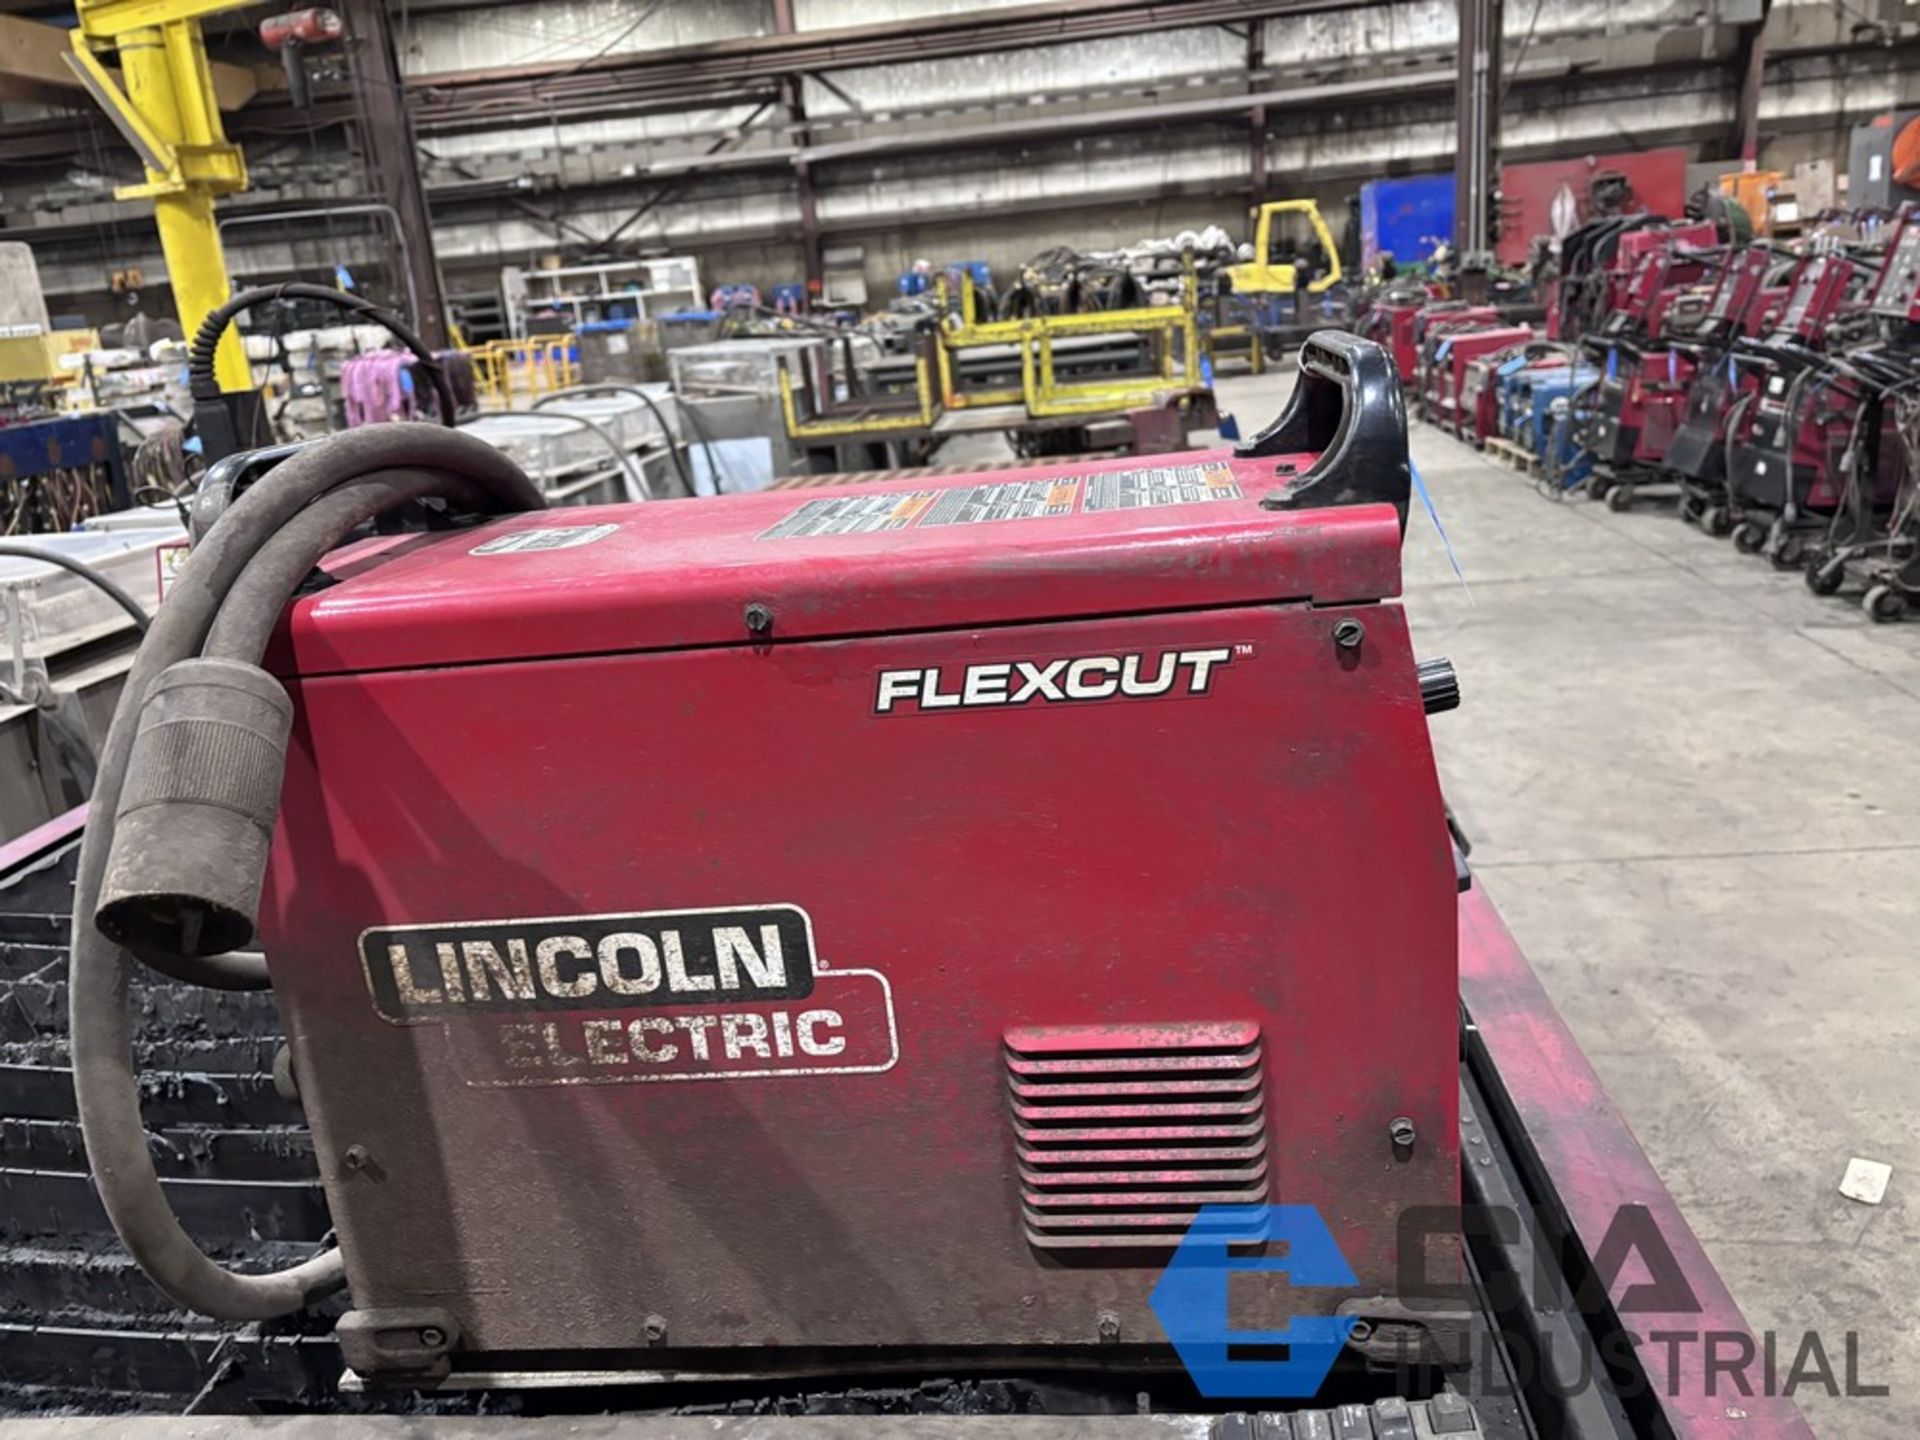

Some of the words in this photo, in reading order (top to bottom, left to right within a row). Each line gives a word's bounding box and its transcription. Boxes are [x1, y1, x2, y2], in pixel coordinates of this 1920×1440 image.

[876, 647, 1231, 712] FLEXCUT
[387, 924, 788, 1004] LINCOLN
[499, 1009, 847, 1068] ELECTRIC
